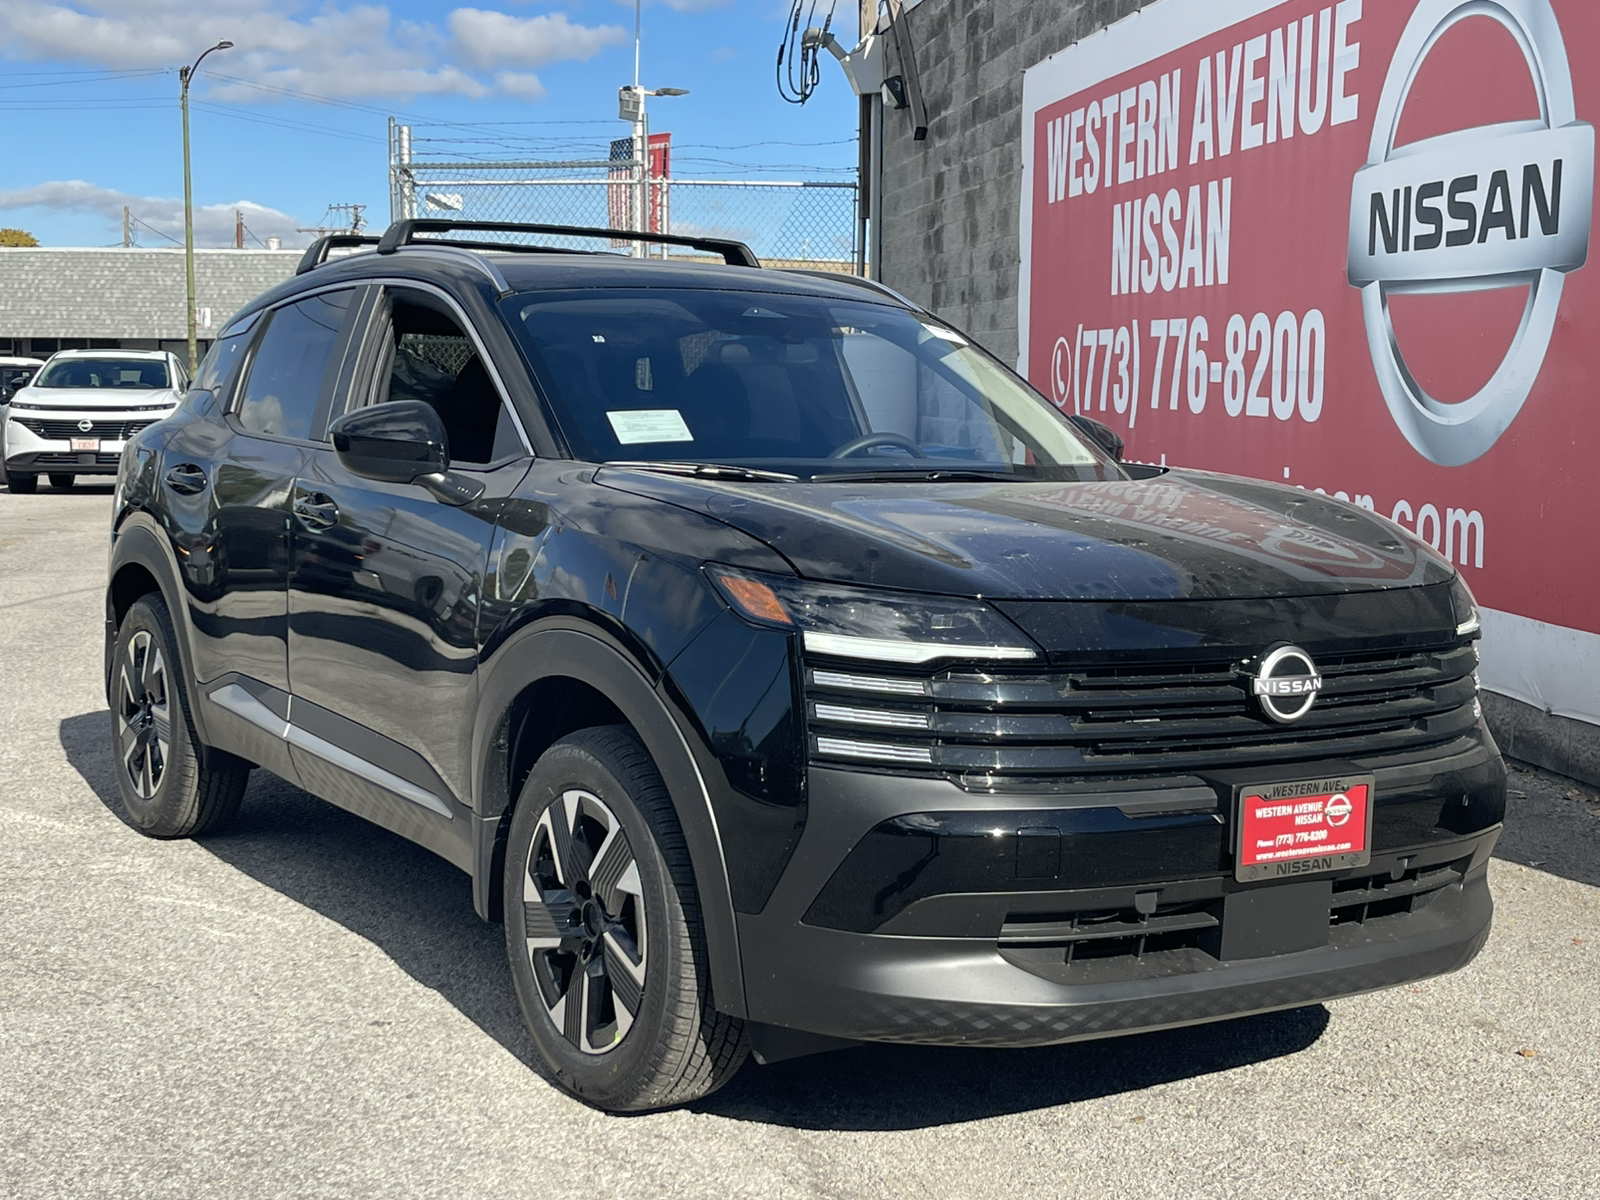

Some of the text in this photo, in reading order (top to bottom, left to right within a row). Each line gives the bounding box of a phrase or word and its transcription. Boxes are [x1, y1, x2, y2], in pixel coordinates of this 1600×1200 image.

[1047, 0, 1363, 204] WESTERN AVENUE
[1368, 158, 1563, 257] NISSAN
[1110, 177, 1233, 296] NISSAN
[1074, 308, 1326, 429] (773) 776-8200
[1256, 677, 1322, 693] NISSAN
[1273, 784, 1319, 797] WESTERN
[1256, 801, 1324, 818] WESTERN AVENUE
[1295, 813, 1323, 826] NISSAN
[1275, 834, 1294, 848] (773)
[1295, 829, 1328, 843] 776-8200
[1277, 858, 1332, 874] NISSAN
